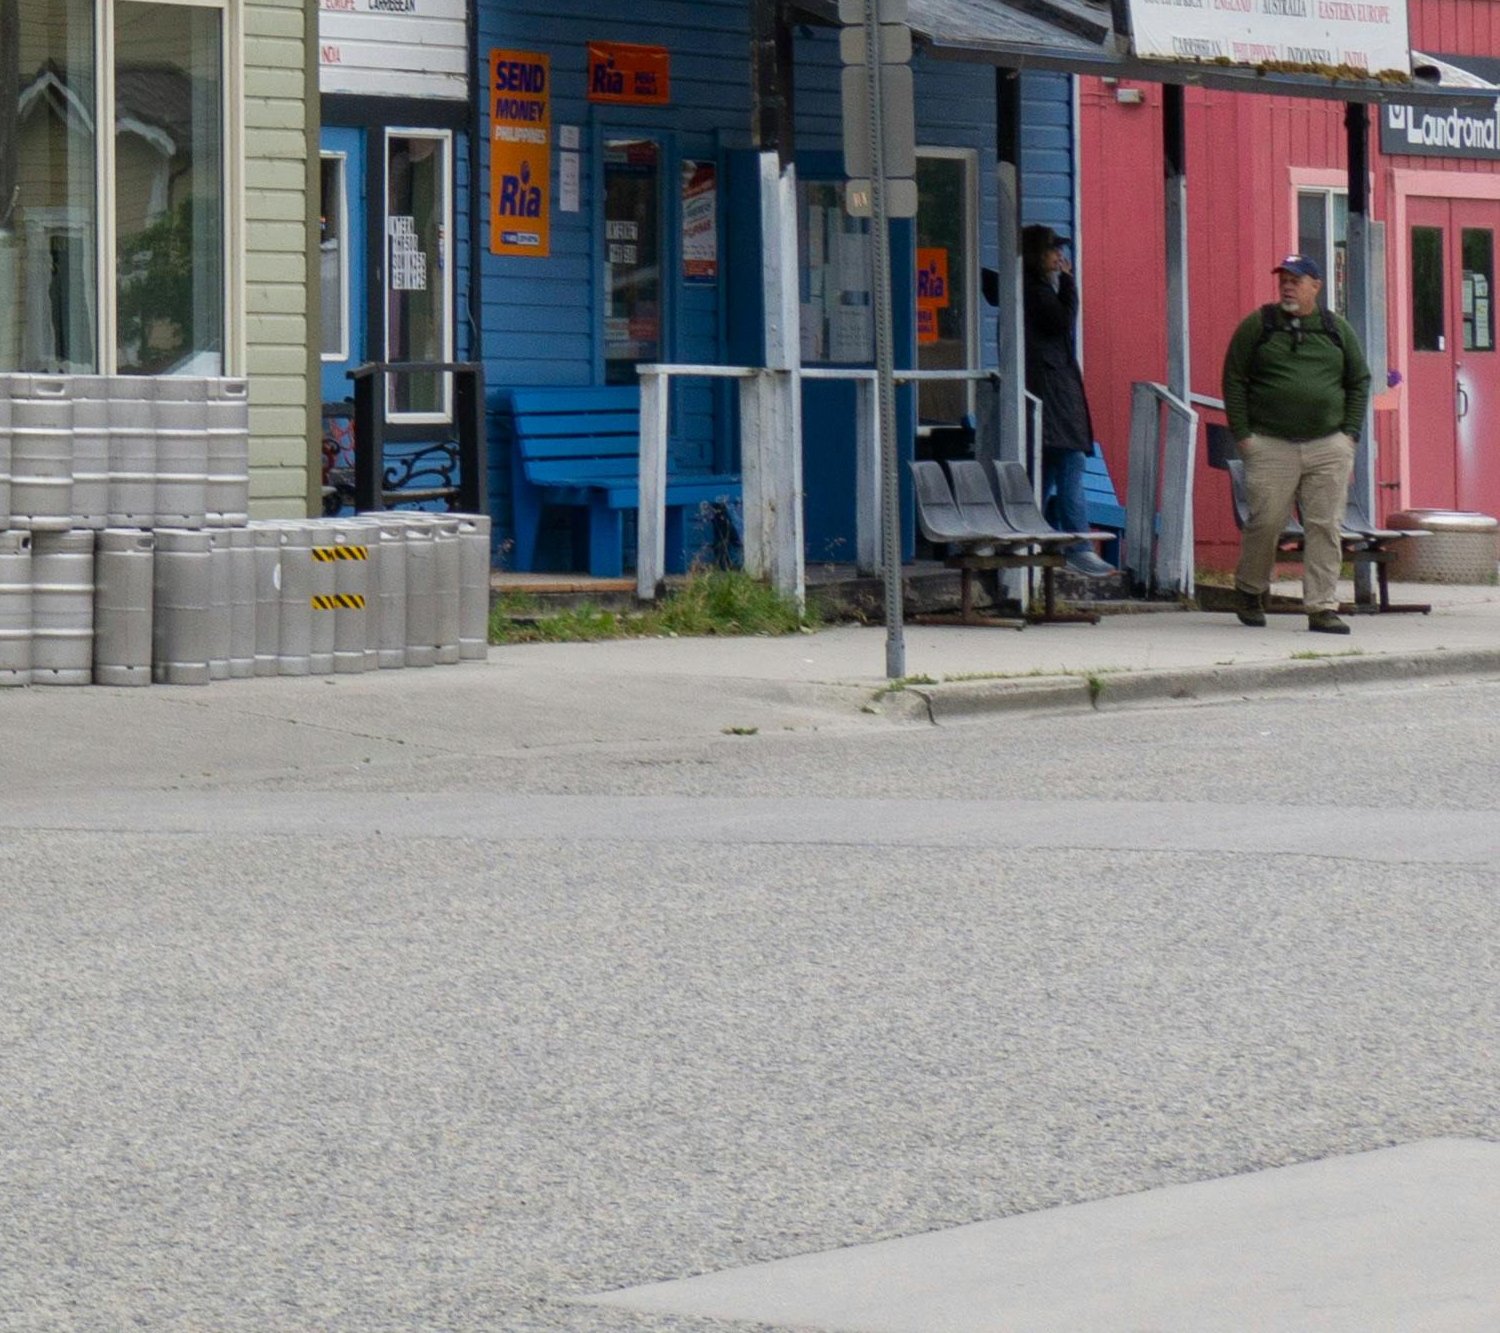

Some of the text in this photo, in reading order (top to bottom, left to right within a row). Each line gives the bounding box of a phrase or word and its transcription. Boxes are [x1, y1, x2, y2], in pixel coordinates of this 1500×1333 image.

[1318, 1, 1356, 22] EASTERN
[1357, 4, 1390, 24] EUROPE
[496, 61, 545, 93] SEND
[593, 55, 624, 94] Ria
[496, 98, 545, 122] MONEY
[499, 163, 541, 218] Ria
[918, 263, 944, 297] Ria
